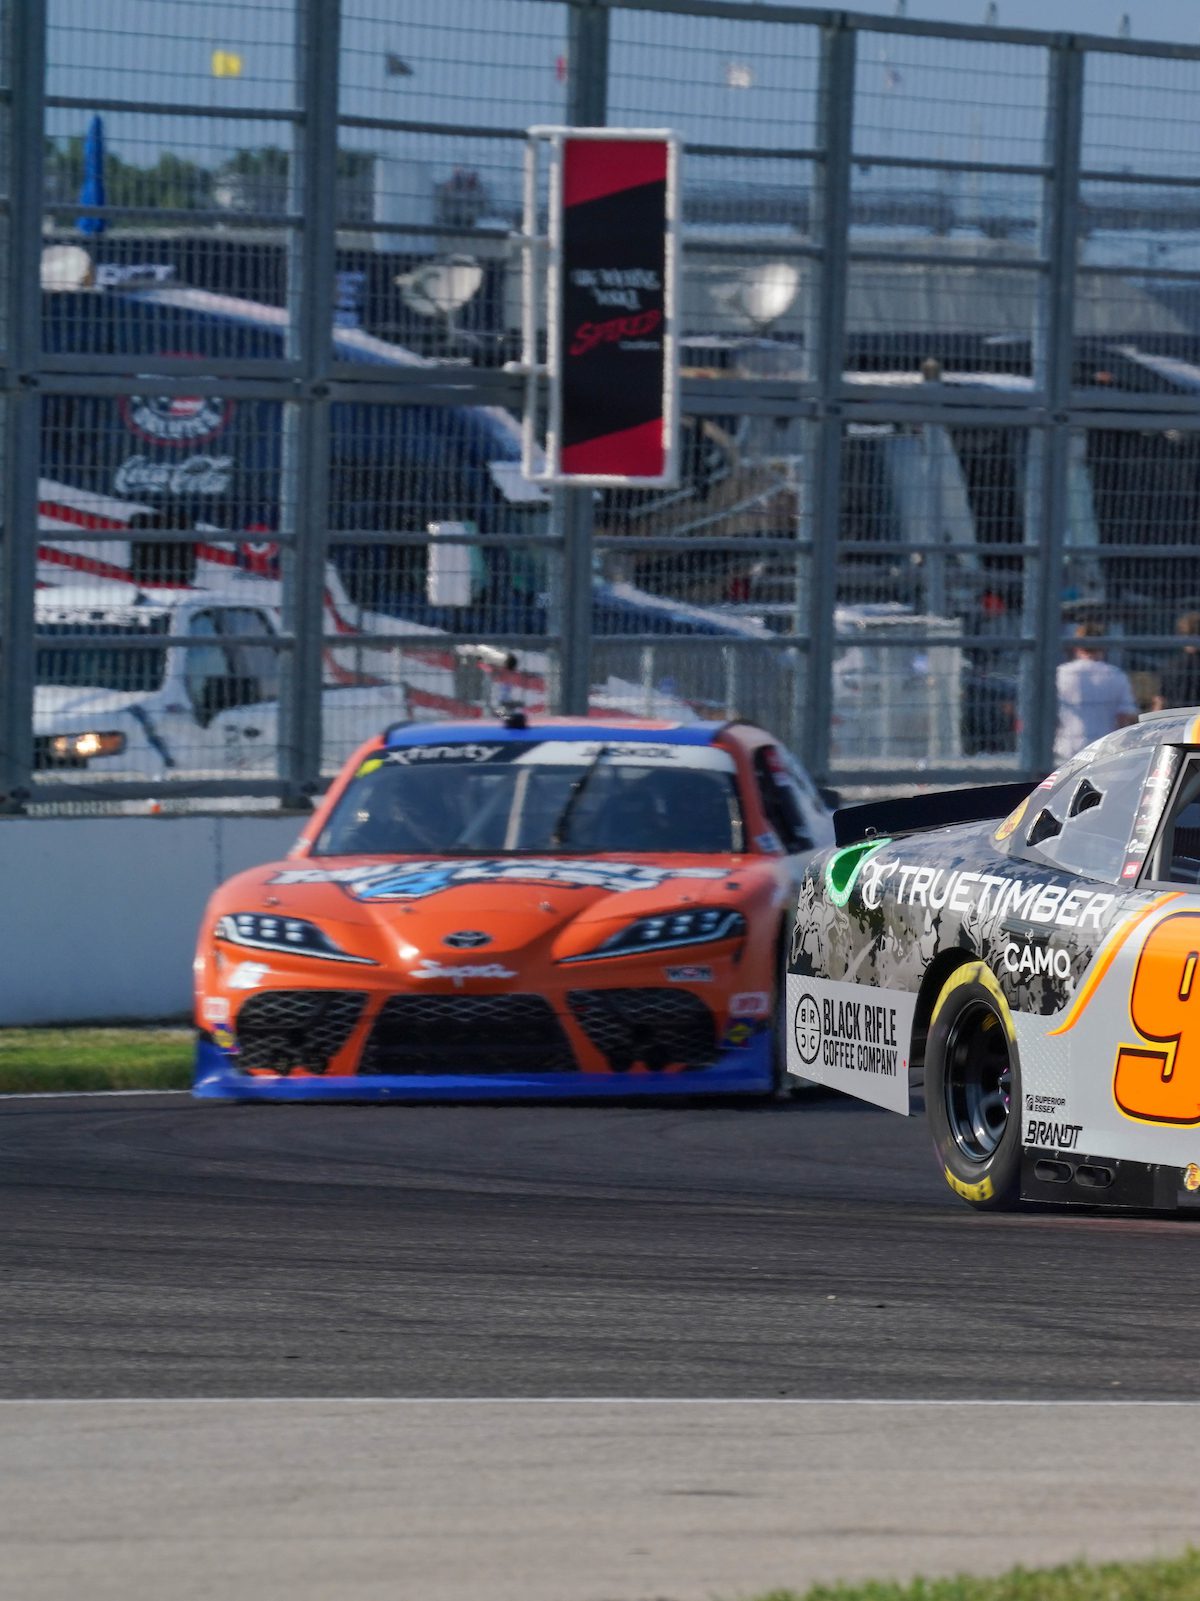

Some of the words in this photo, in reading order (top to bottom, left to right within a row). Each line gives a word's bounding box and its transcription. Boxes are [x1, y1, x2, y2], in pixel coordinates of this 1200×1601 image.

[384, 745, 504, 764] xfinity
[897, 865, 1119, 928] TRUETIMBER
[408, 959, 520, 987] Supra
[1003, 942, 1071, 978] CAMO
[823, 998, 861, 1040] BLACK
[864, 1004, 897, 1047] RIFLE
[823, 1039, 855, 1070] COFFEE
[857, 1044, 898, 1077] COMPANY
[1034, 1095, 1066, 1106] SUPERIOR
[1034, 1104, 1056, 1114] ESSEX
[1024, 1120, 1084, 1149] BRANDT
